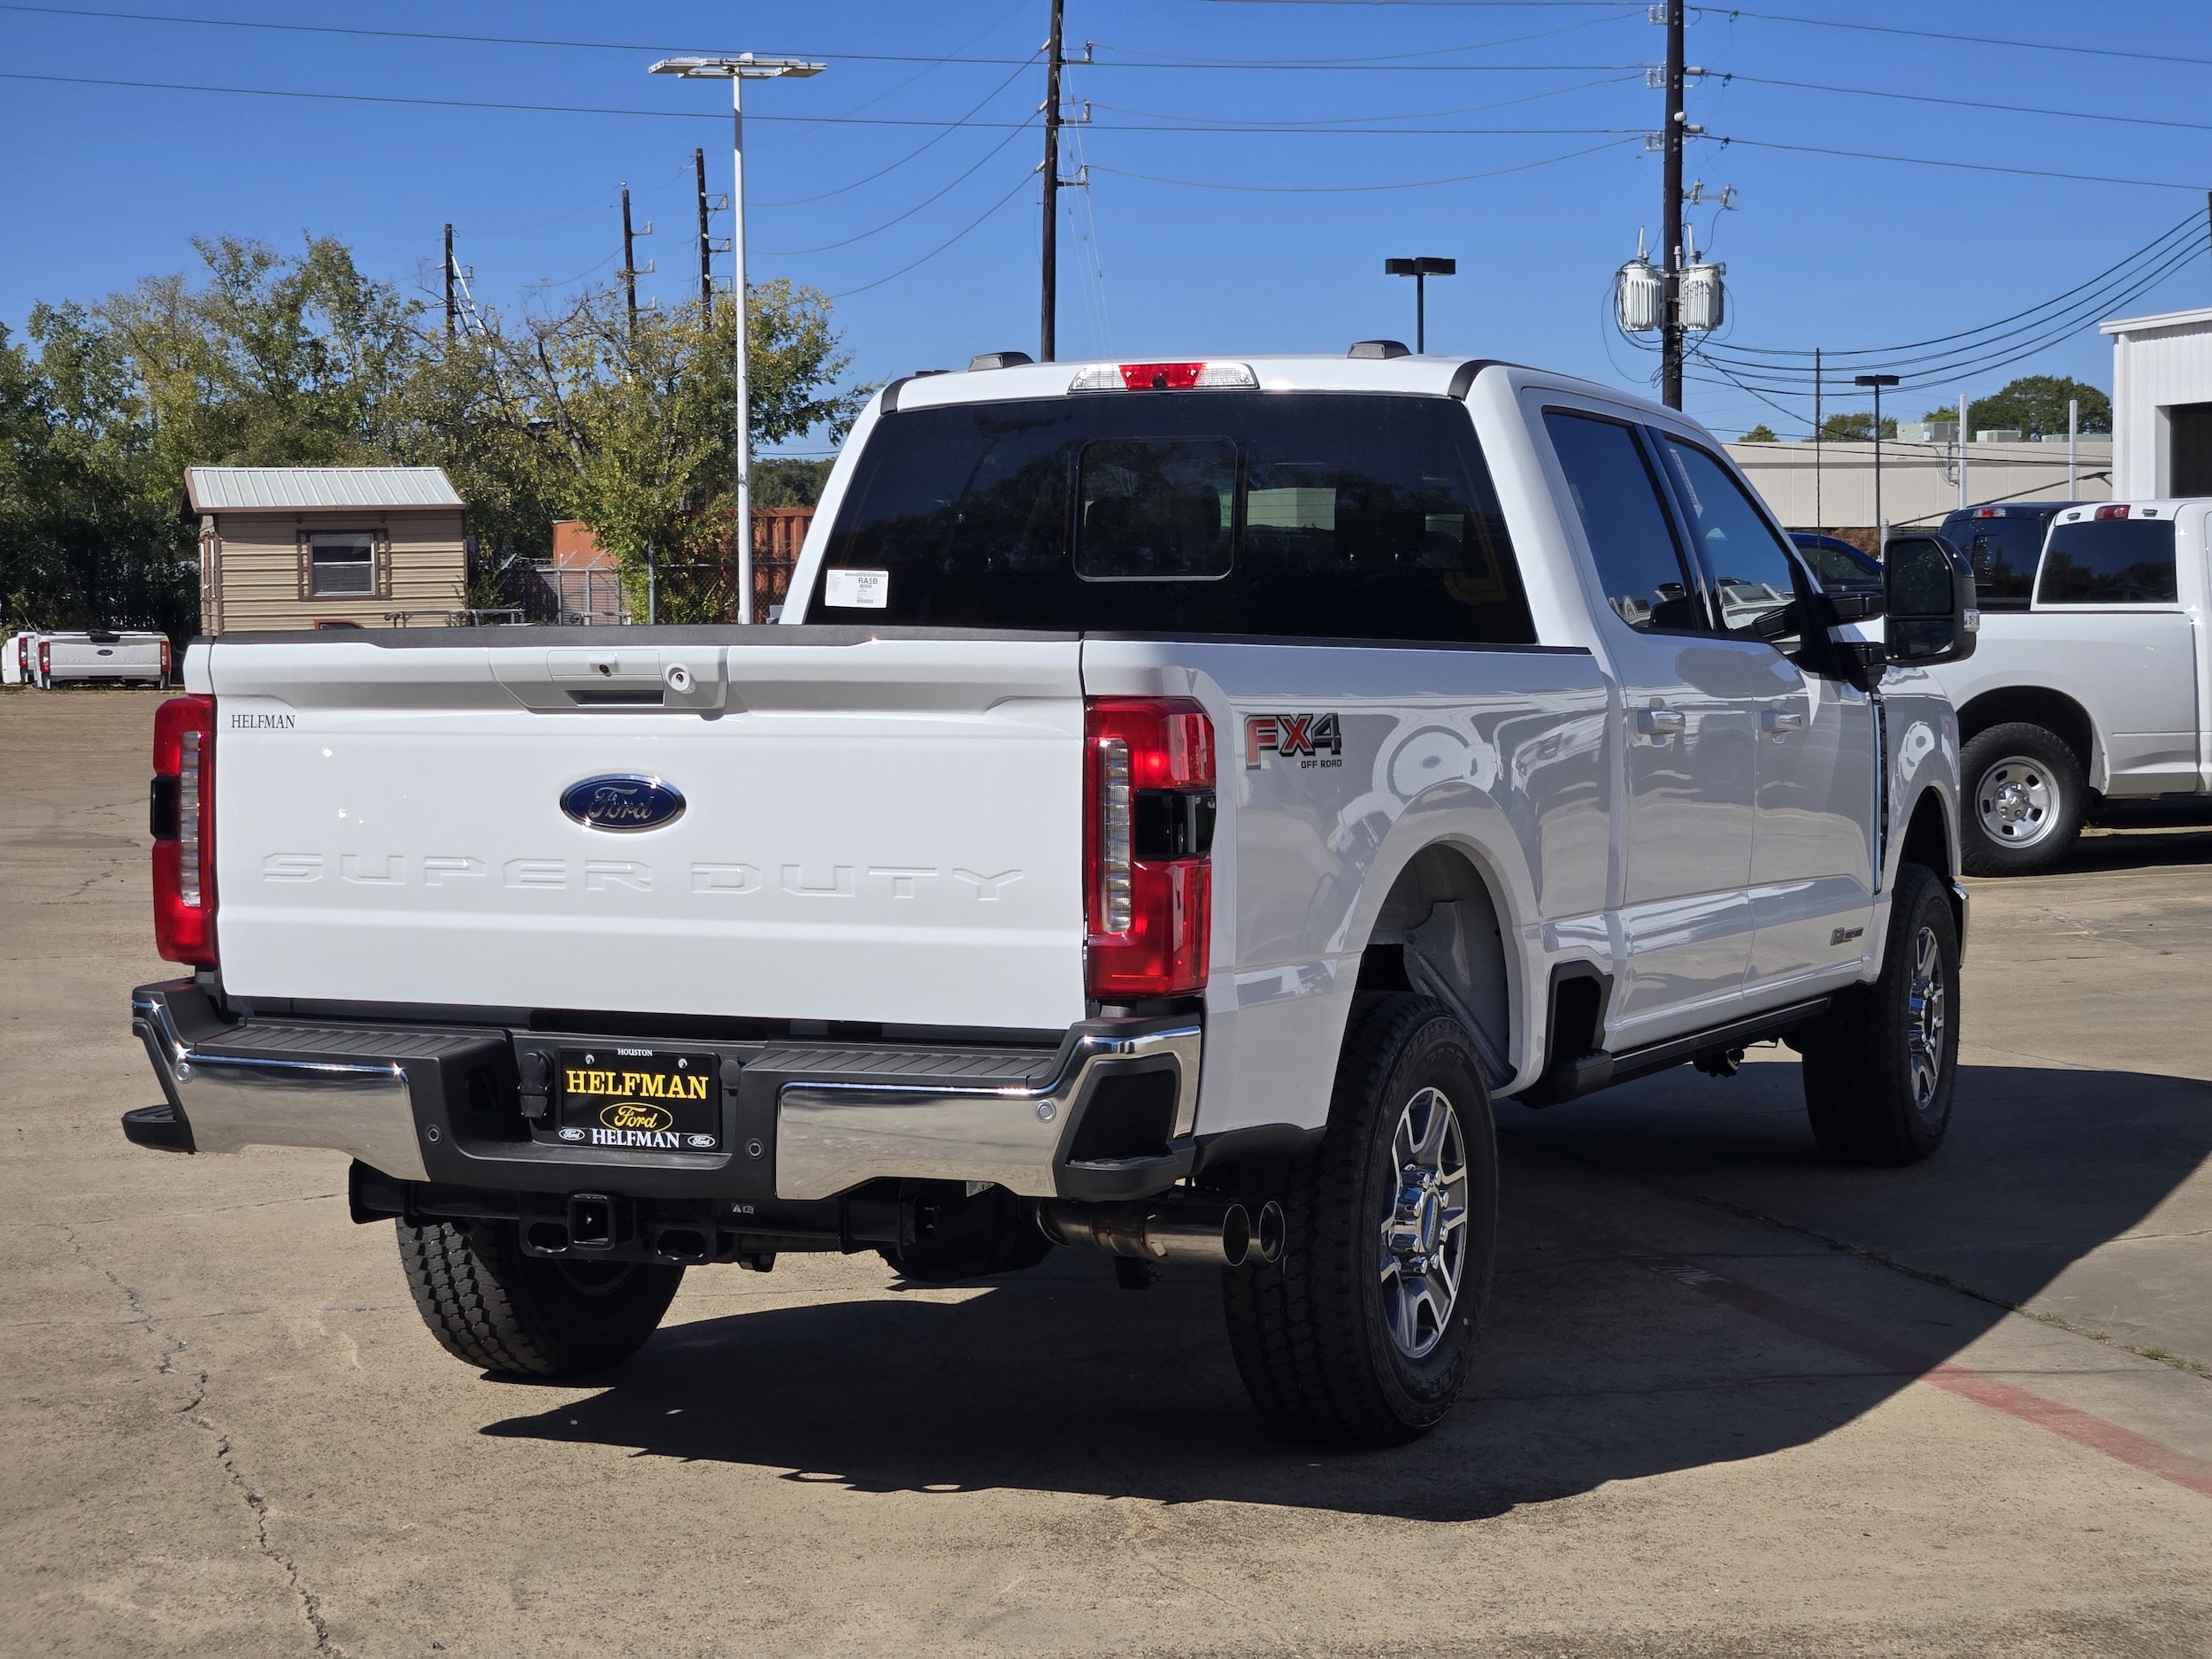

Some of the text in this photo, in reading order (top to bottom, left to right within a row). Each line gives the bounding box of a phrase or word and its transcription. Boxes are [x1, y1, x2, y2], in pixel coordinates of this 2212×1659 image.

[231, 714, 296, 729] HELFMAN
[1244, 712, 1342, 770] FX4
[1301, 759, 1342, 769] OFF ROAD
[588, 787, 657, 819] Ford
[263, 852, 1025, 901] SUPER DUTY
[617, 1048, 654, 1057] HOUSTON
[565, 1069, 710, 1100] HELFMAN
[613, 1105, 658, 1129] Ford
[591, 1127, 680, 1148] HELFMAN
